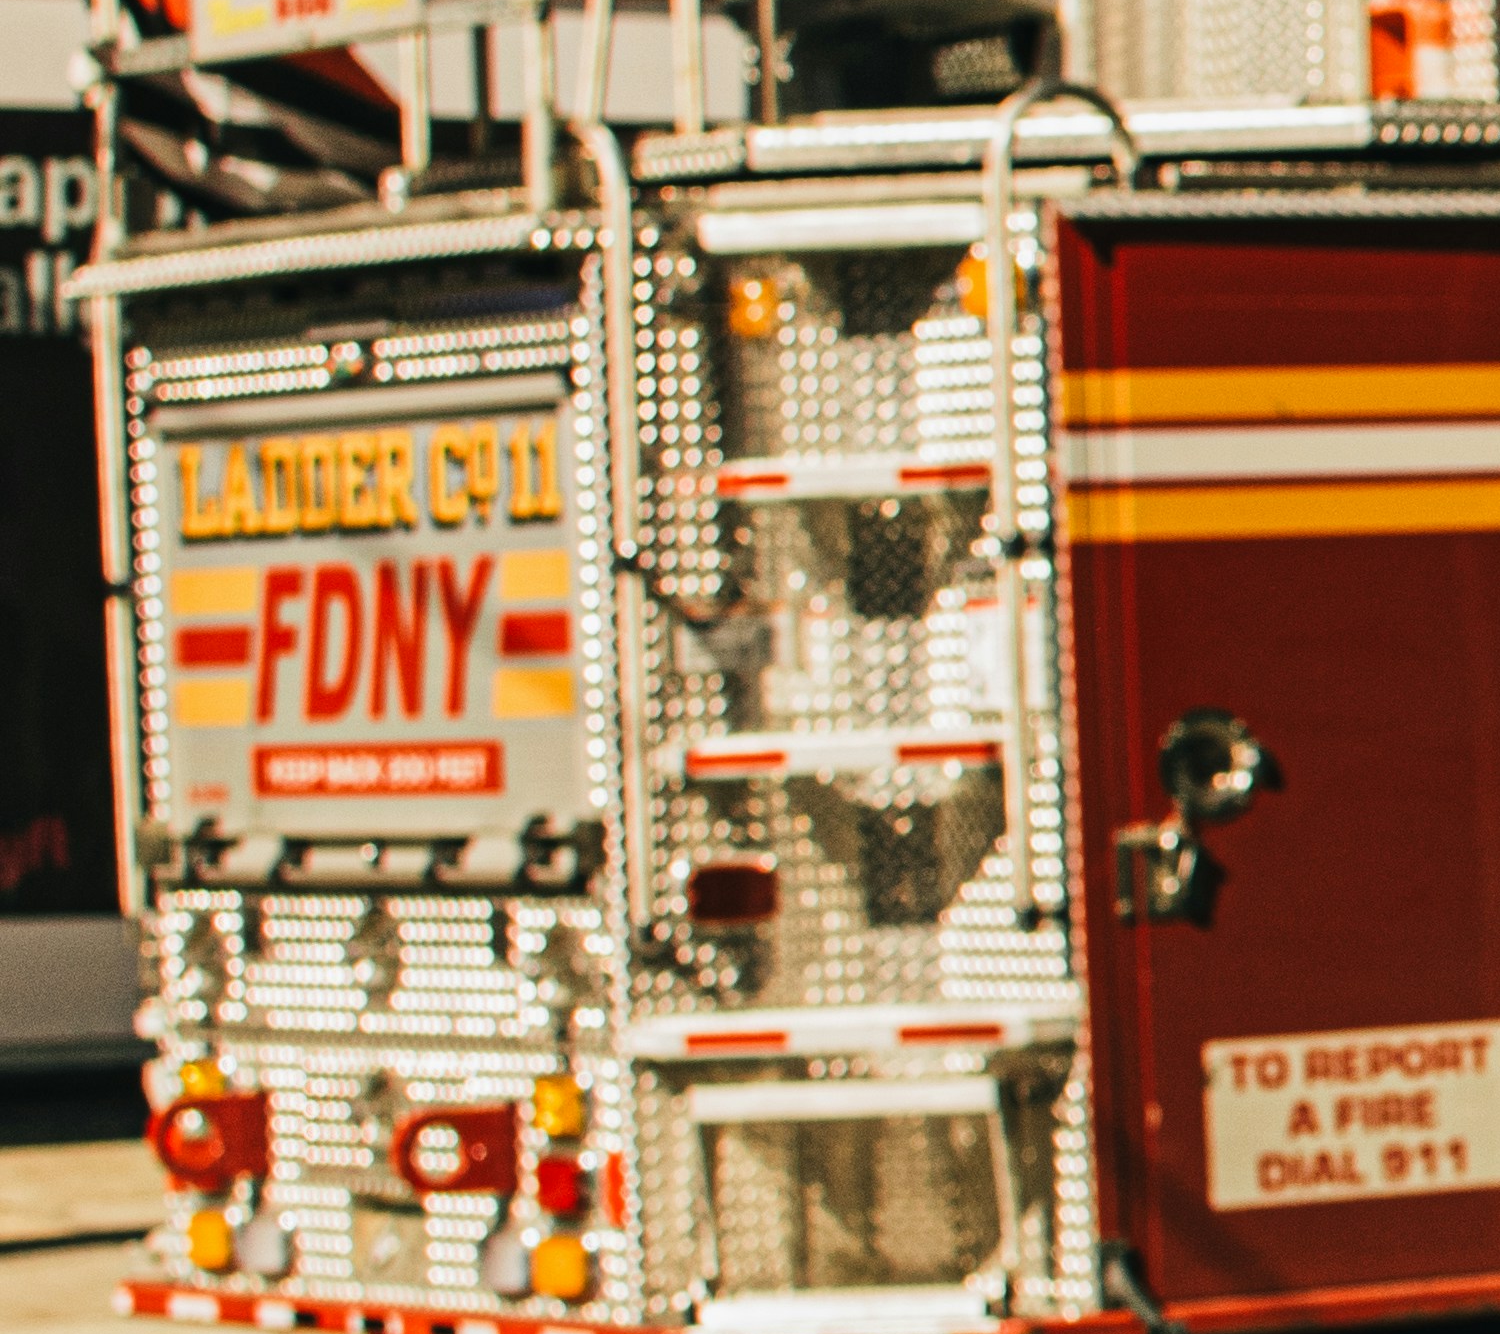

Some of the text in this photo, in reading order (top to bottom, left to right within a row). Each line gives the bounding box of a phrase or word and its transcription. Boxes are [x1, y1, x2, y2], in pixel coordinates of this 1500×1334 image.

[179, 428, 420, 544] LADDER
[508, 419, 564, 523] 11
[254, 552, 495, 724] FDNY
[1231, 1035, 1489, 1091] TO REPORT
[1287, 1087, 1437, 1139] A FIRE
[1256, 1135, 1469, 1193] DIAL 911
